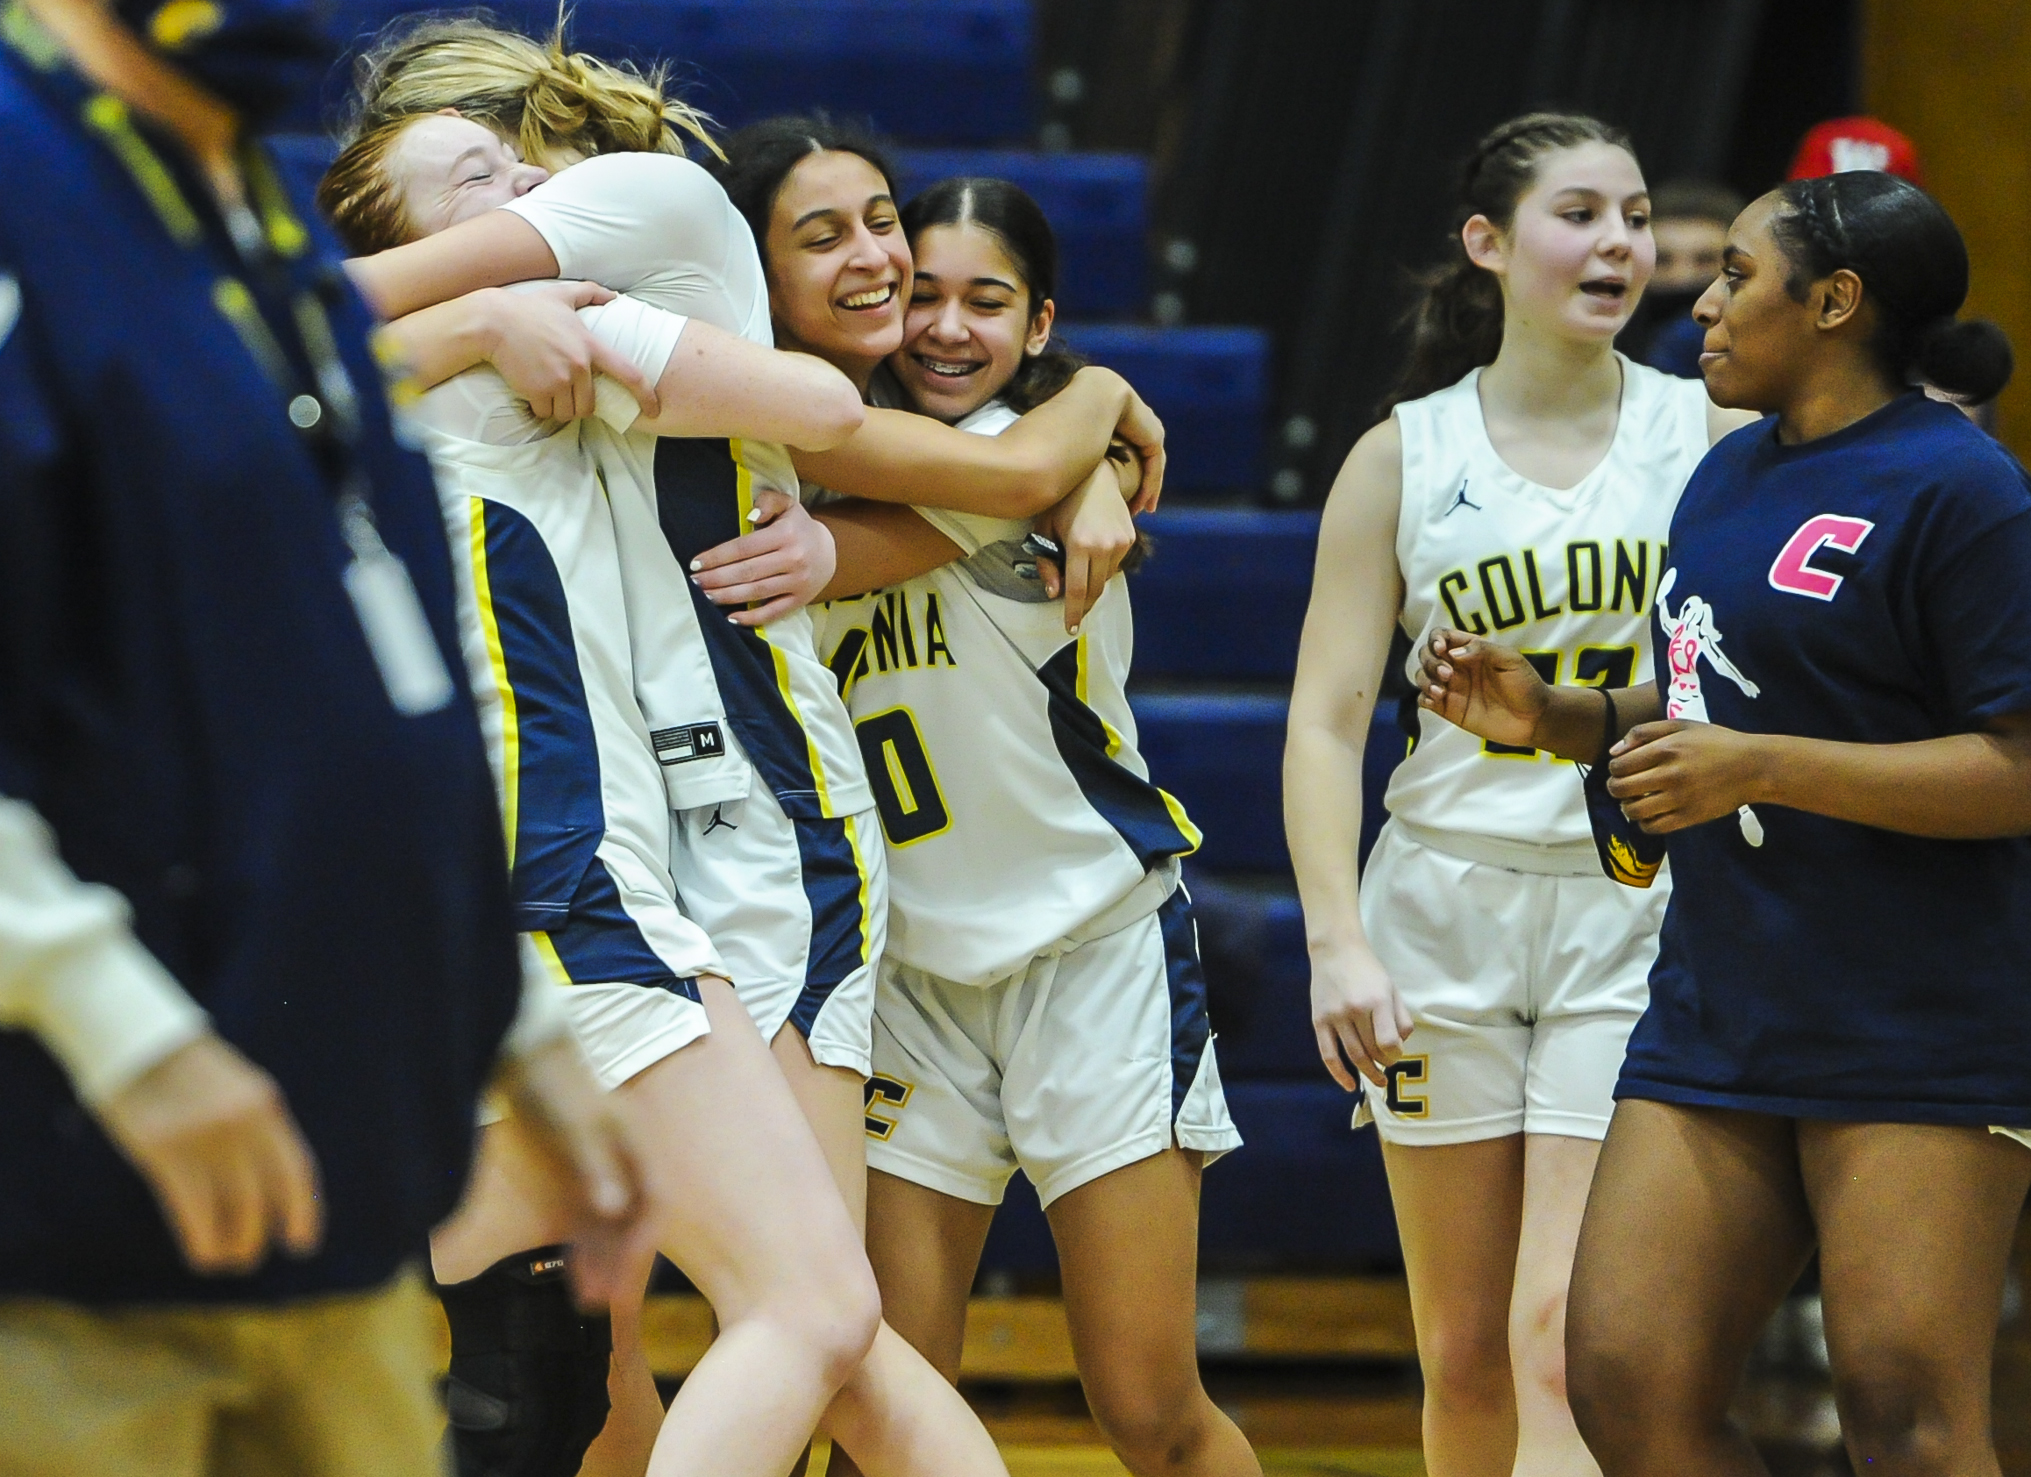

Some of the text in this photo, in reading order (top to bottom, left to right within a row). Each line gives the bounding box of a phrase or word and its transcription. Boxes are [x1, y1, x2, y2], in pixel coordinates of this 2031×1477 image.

[1768, 513, 1876, 602] C
[700, 732, 715, 748] M
[863, 1072, 915, 1142] C
[1384, 1054, 1430, 1119] C
